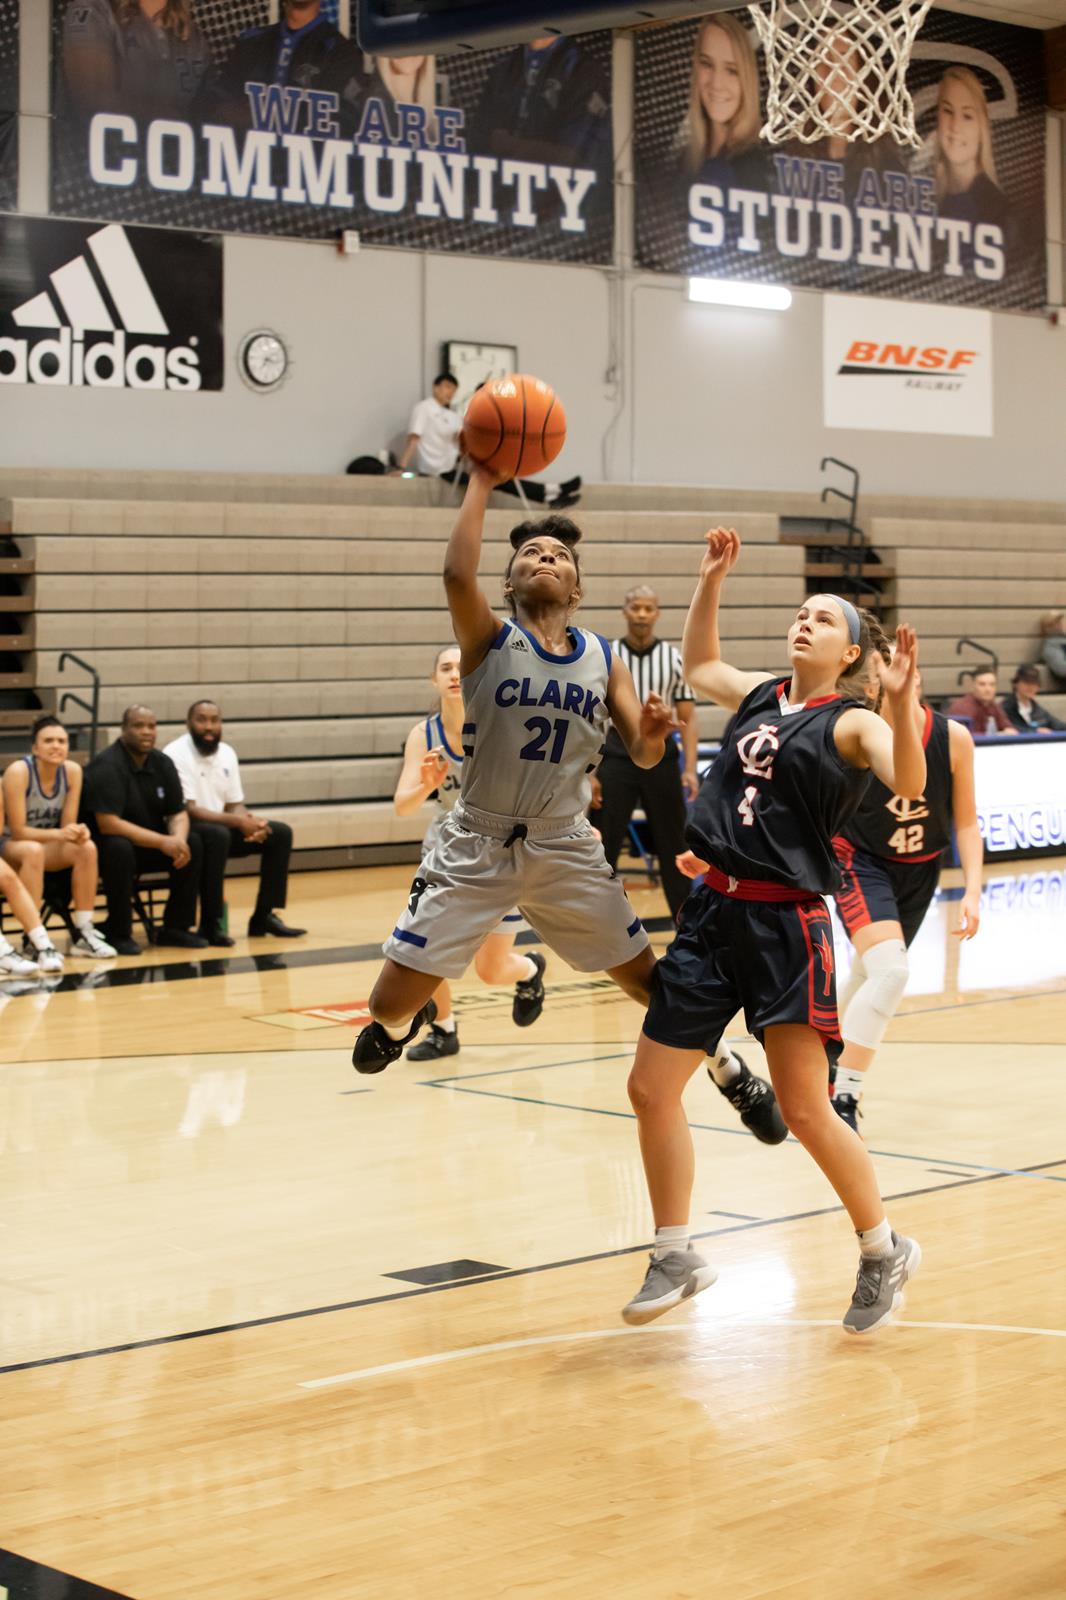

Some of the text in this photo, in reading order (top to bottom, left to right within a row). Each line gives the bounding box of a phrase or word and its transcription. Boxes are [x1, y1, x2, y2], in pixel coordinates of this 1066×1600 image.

[244, 81, 466, 153] WE ARE
[88, 112, 597, 232] COMMUNITY
[773, 152, 938, 218] WE ARE
[688, 183, 1005, 281] STUDENTS
[0, 325, 202, 391] adidas
[845, 340, 978, 370] BNSF
[494, 677, 601, 726] CLARK
[519, 715, 570, 764] 21
[737, 785, 757, 826] 4
[887, 824, 925, 855] 42
